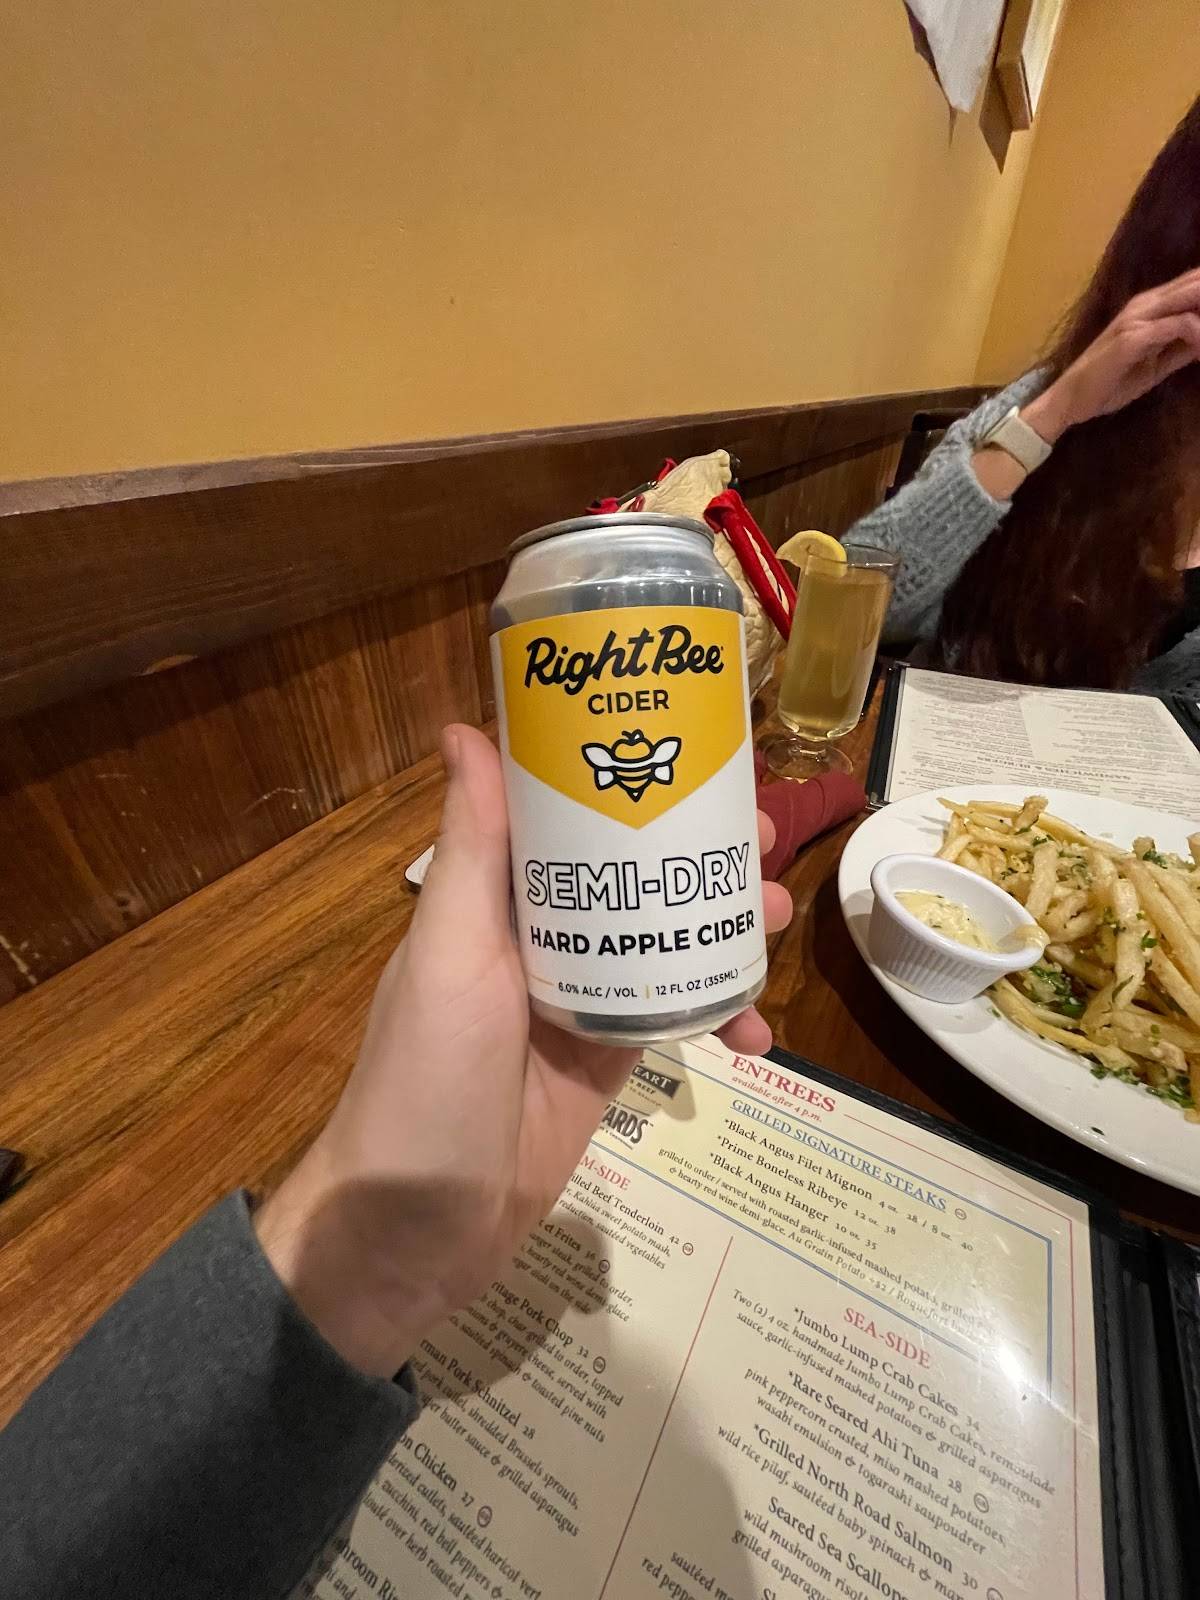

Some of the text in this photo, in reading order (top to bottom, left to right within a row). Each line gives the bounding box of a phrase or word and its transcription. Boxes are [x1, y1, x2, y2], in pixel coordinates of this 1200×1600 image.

[524, 624, 725, 696] Right Bee
[587, 689, 670, 715] CIDER
[525, 842, 750, 911] SEMI-DRY
[530, 909, 755, 956] HARD APPLE CIDER
[558, 981, 579, 994] 6.0%
[582, 986, 602, 998] ALC
[615, 987, 638, 998] VOL
[655, 986, 667, 996] 12
[670, 983, 683, 994] FL
[686, 980, 701, 992] OZ
[704, 968, 739, 989] (355ML)
[633, 1066, 672, 1089] EART
[730, 1054, 836, 1113] ENTREES
[731, 1076, 822, 1122] available after p.m.
[601, 1103, 648, 1145] ARDS
[730, 1099, 946, 1213] GRILLED SIGNATURE STEAKS
[580, 1155, 631, 1191] M-SIDE
[744, 1172, 781, 1198] Angus
[783, 1191, 829, 1222] Hanger
[755, 1154, 804, 1187] Boneless
[806, 1180, 848, 1210] Ribeye
[883, 1225, 896, 1235] 38
[758, 1137, 794, 1161] Angus
[796, 1154, 823, 1175] Filet
[824, 1168, 872, 1200] Mignon
[553, 1226, 581, 1252] Frites
[591, 1184, 680, 1245] Beef Tenderloin 42
[600, 1209, 622, 1225] sweet
[619, 1221, 647, 1241] potato
[647, 1237, 670, 1257] mash,
[657, 1148, 902, 1285] grilled to order served with roasted garlic-infused mashed
[677, 1168, 703, 1190] hearty
[702, 1185, 718, 1197] red
[718, 1192, 738, 1208] wine
[787, 1231, 803, 1244] Au
[803, 1239, 834, 1262] Gratin
[834, 1255, 866, 1279] Potato
[625, 1240, 666, 1269] vegetables
[490, 1280, 520, 1306] ritage
[518, 1297, 545, 1325] Pork
[544, 1317, 573, 1349] Chop
[576, 1345, 589, 1359] 32
[599, 1277, 633, 1307] to order,
[843, 1307, 930, 1369] SEA-SIDE
[446, 1357, 472, 1388] Pork
[471, 1379, 522, 1428] Schnitzel
[522, 1425, 536, 1440] 28
[527, 1353, 607, 1419] cheese, served with
[553, 1349, 565, 1362] to
[563, 1359, 589, 1384] order,
[590, 1377, 624, 1407] topped
[733, 1288, 752, 1308] Two
[791, 1325, 845, 1366] handmade
[844, 1359, 881, 1389] Jumbo
[883, 1381, 915, 1412] Lump
[918, 1404, 947, 1429] Crab
[949, 1423, 987, 1456] Cakes,
[840, 1335, 879, 1370] Lump
[881, 1361, 915, 1390] Crab
[917, 1383, 958, 1417] Cakes
[965, 1415, 980, 1432] 34
[530, 1378, 605, 1443] toasted pine nuts
[736, 1312, 764, 1336] sauce,
[764, 1331, 834, 1378] garlic-infused
[833, 1373, 876, 1405] mashed
[874, 1400, 923, 1436] potatoes
[937, 1440, 976, 1468] grilled
[978, 1465, 1041, 1509] asparagus
[743, 1368, 769, 1389] pink
[767, 1384, 827, 1428] peppercorn
[827, 1423, 869, 1458] crusted,
[872, 1452, 900, 1476] miso
[902, 1471, 949, 1508] mashed
[413, 1442, 475, 1508] Chicken 27
[439, 1406, 468, 1436] butter
[464, 1433, 491, 1458] sauce
[497, 1464, 533, 1495] grilled
[529, 1490, 579, 1537] asparagus
[467, 1407, 578, 1510] shredded Brussels sprouts,
[757, 1395, 794, 1426] wasabi
[793, 1422, 842, 1461] emulsion
[857, 1463, 913, 1507] togarashi
[913, 1502, 986, 1555] saupoudrer
[824, 1394, 869, 1434] Seared
[871, 1427, 898, 1453] Ahi
[901, 1441, 938, 1479] Tuna
[947, 1478, 962, 1494] 28
[717, 1425, 916, 1573] wild rice pilaf, sautéed baby spinach
[768, 1496, 842, 1563] Seared Sea
[806, 1459, 849, 1502] North
[852, 1491, 891, 1530] Road
[893, 1520, 952, 1573] Salmon
[961, 1571, 979, 1590] 30
[337, 1537, 379, 1589] hroom
[381, 1479, 491, 1591] zucchini, red bell peppers
[384, 1517, 466, 1597] over herb roasted
[416, 1483, 447, 1518] cutlets,
[447, 1512, 488, 1550] sautéed
[482, 1540, 521, 1583] haricot
[731, 1529, 772, 1562] grilled
[743, 1509, 832, 1582] wild mushroom
[641, 1557, 663, 1579] red
[670, 1551, 716, 1592] sautéed
